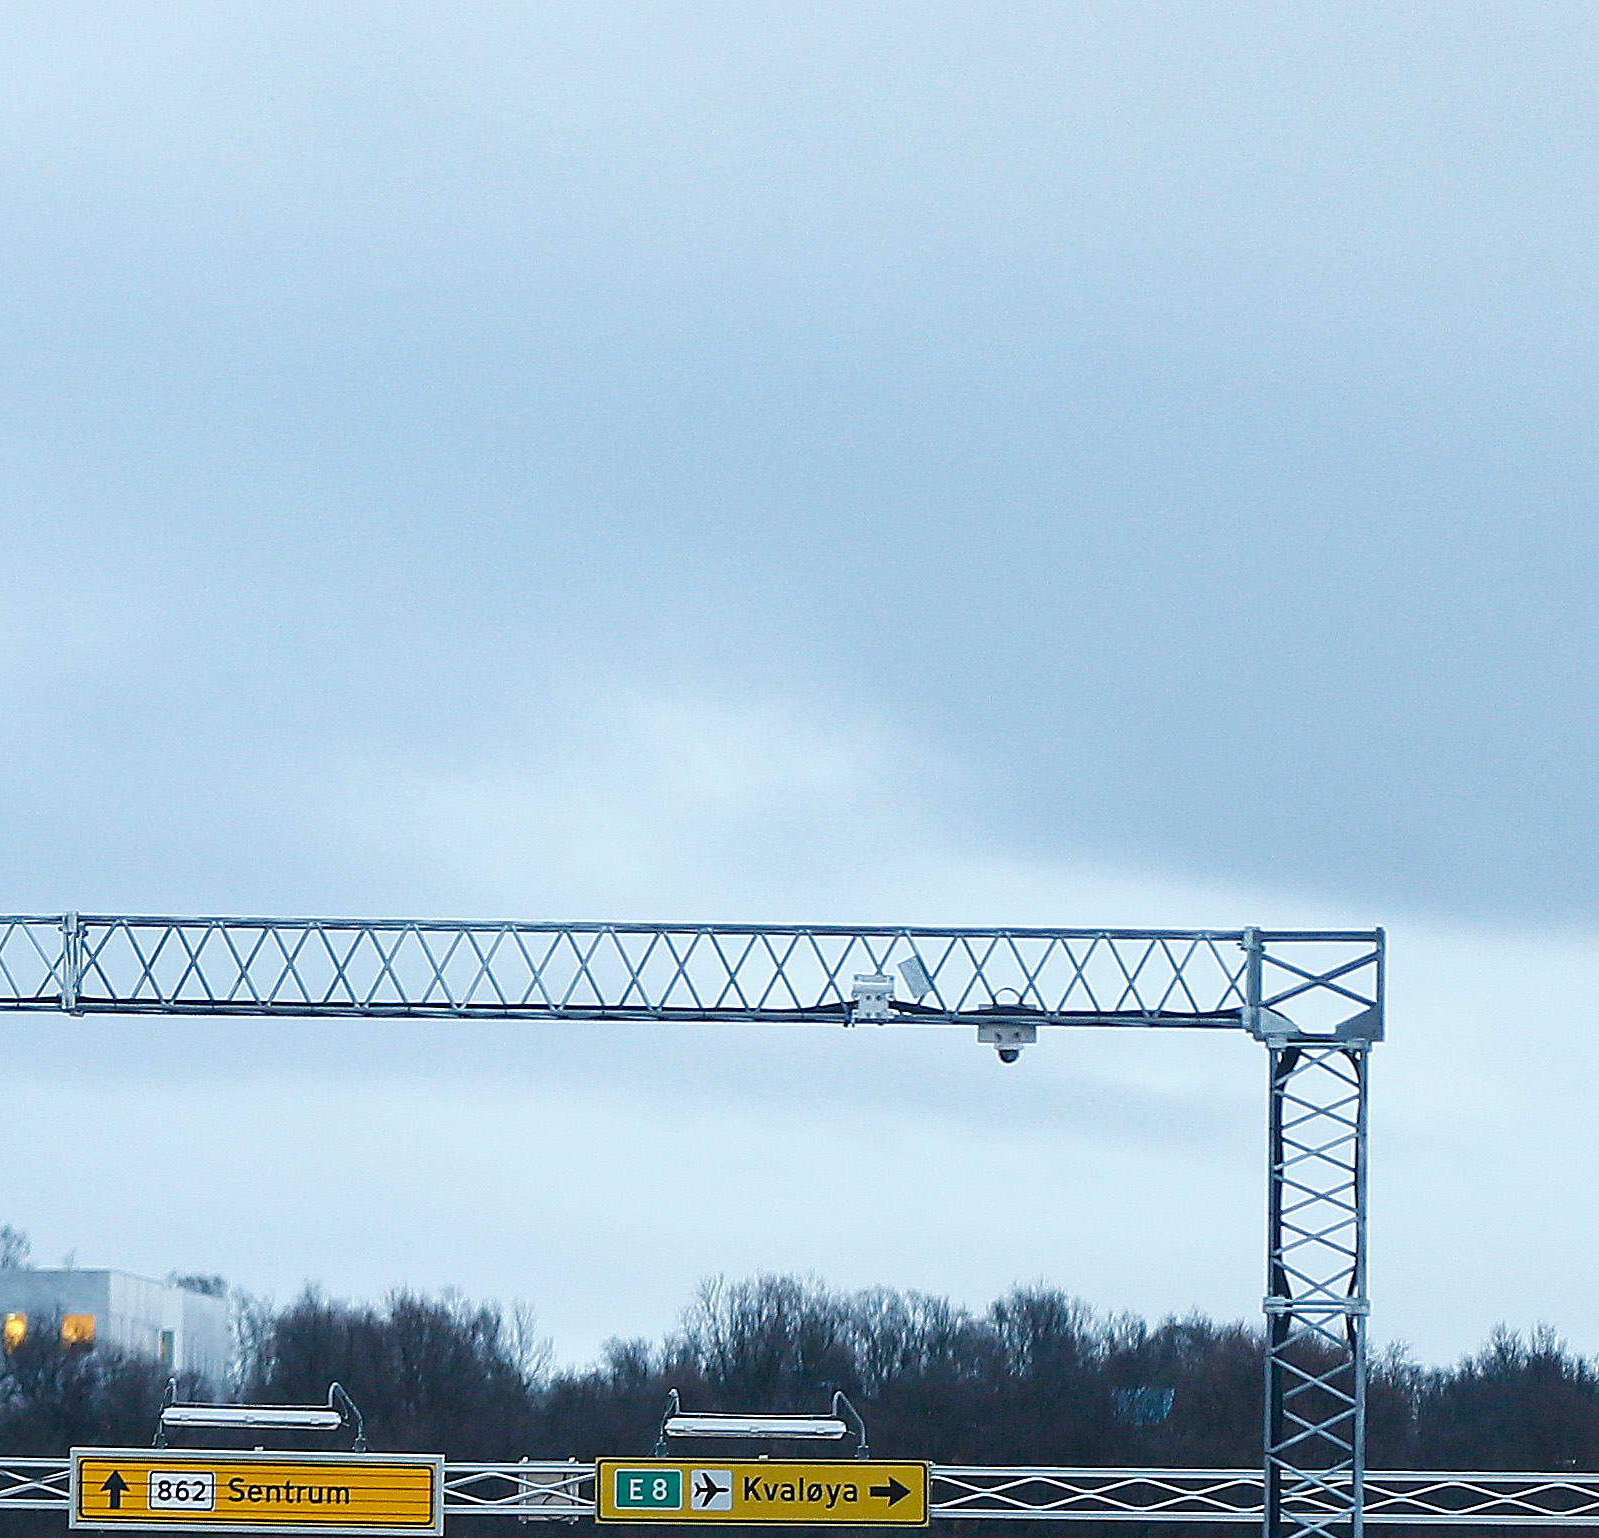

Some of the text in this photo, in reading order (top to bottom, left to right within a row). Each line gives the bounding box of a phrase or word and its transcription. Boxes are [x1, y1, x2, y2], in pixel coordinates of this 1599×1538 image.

[157, 1478, 350, 1504] 862 Sentrum
[743, 1477, 859, 1506] Kvaløya
